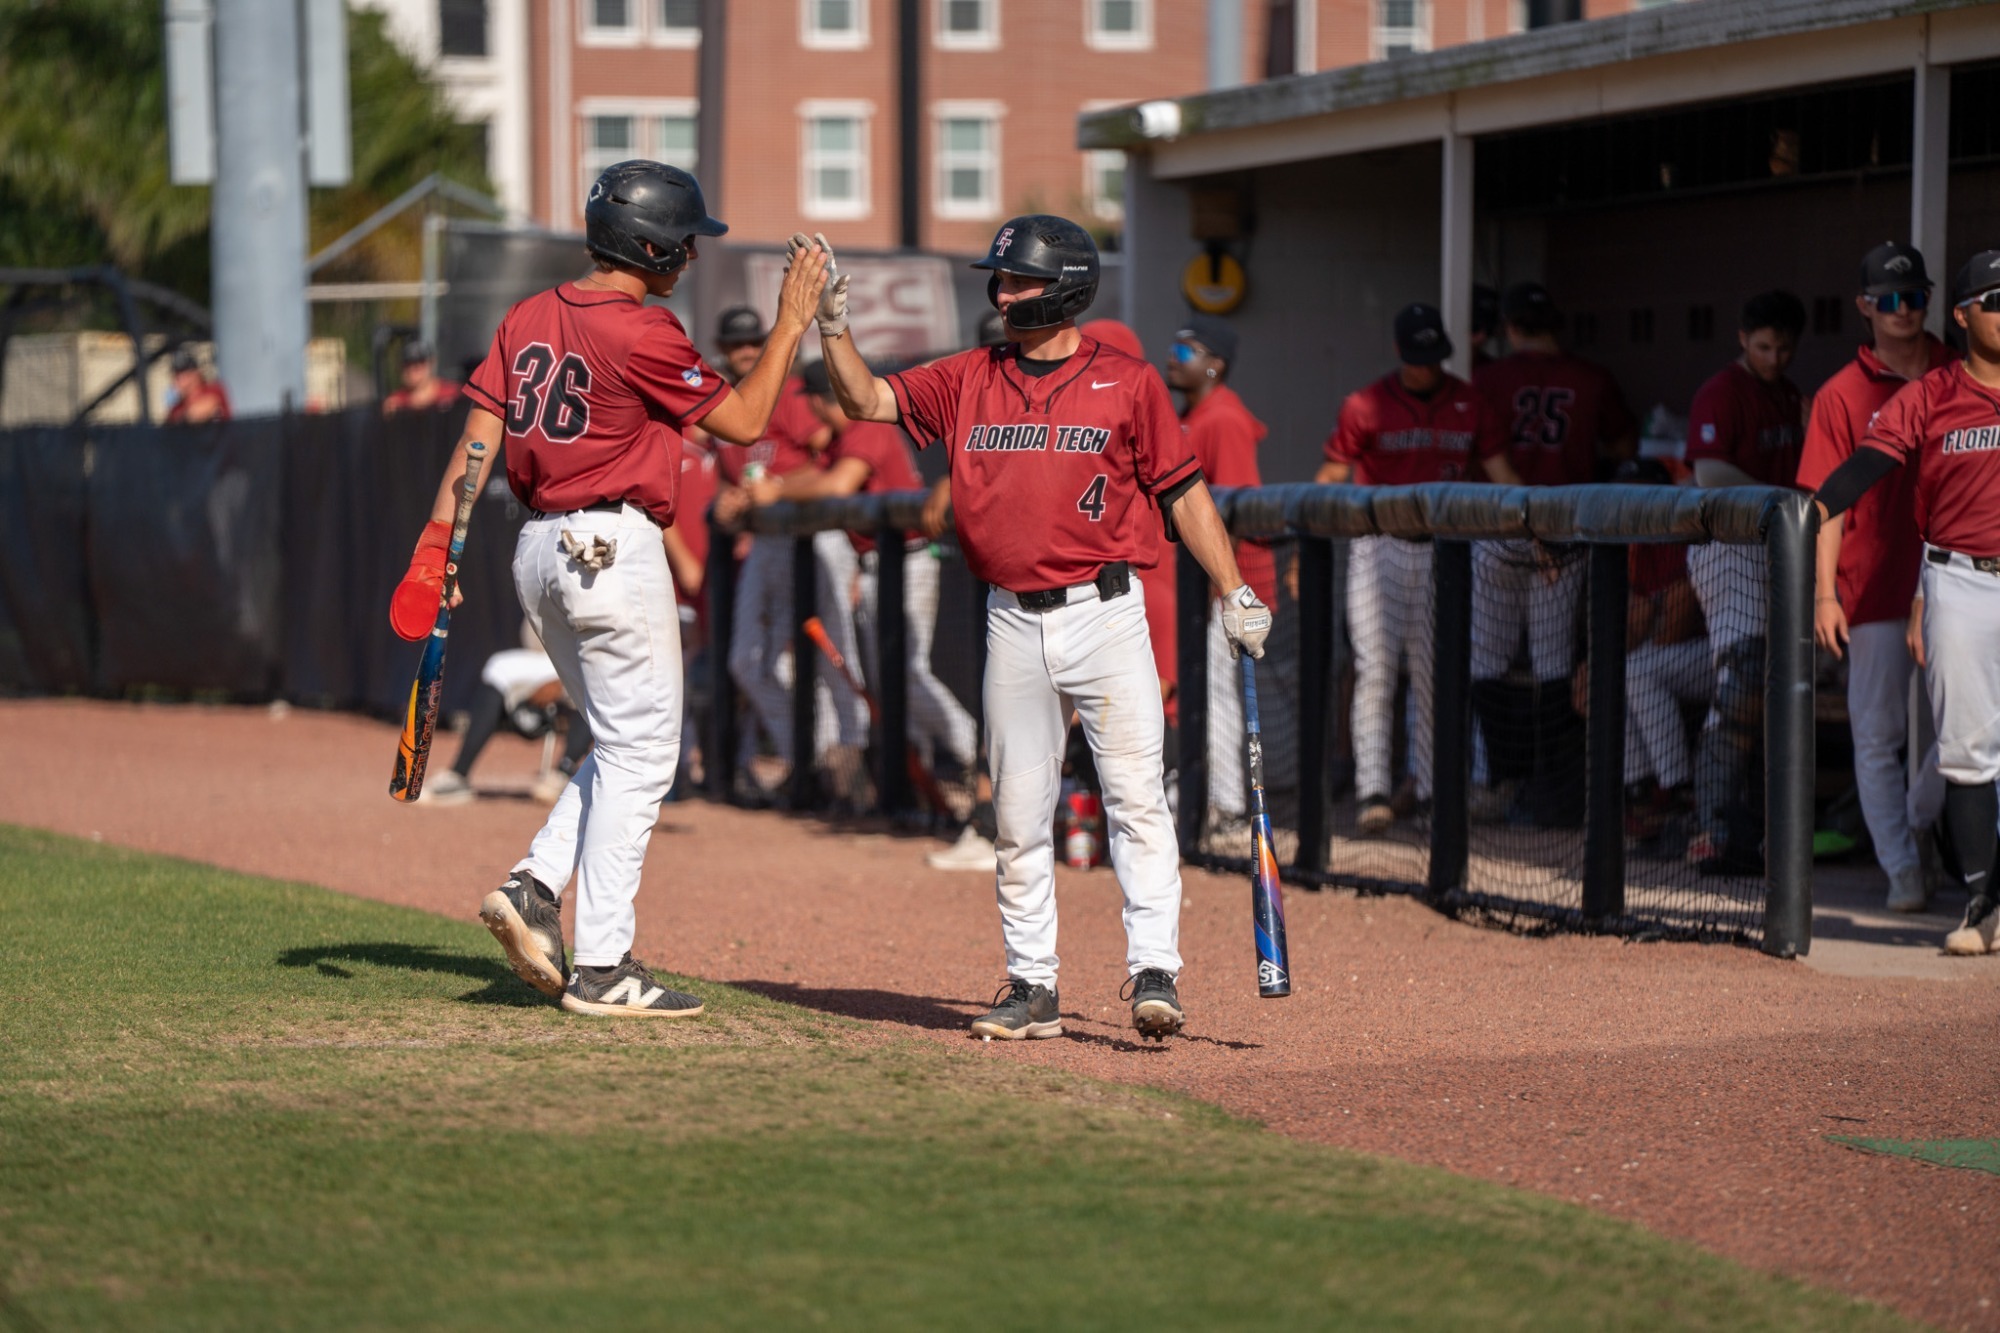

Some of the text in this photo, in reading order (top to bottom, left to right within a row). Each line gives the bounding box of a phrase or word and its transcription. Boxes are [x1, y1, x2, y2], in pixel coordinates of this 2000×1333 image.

[506, 341, 592, 444] 36
[965, 424, 1111, 454] FLORIDA TECH
[1512, 385, 1576, 450] 25
[1942, 424, 2000, 455] FLORI
[1077, 474, 1108, 521] 4
